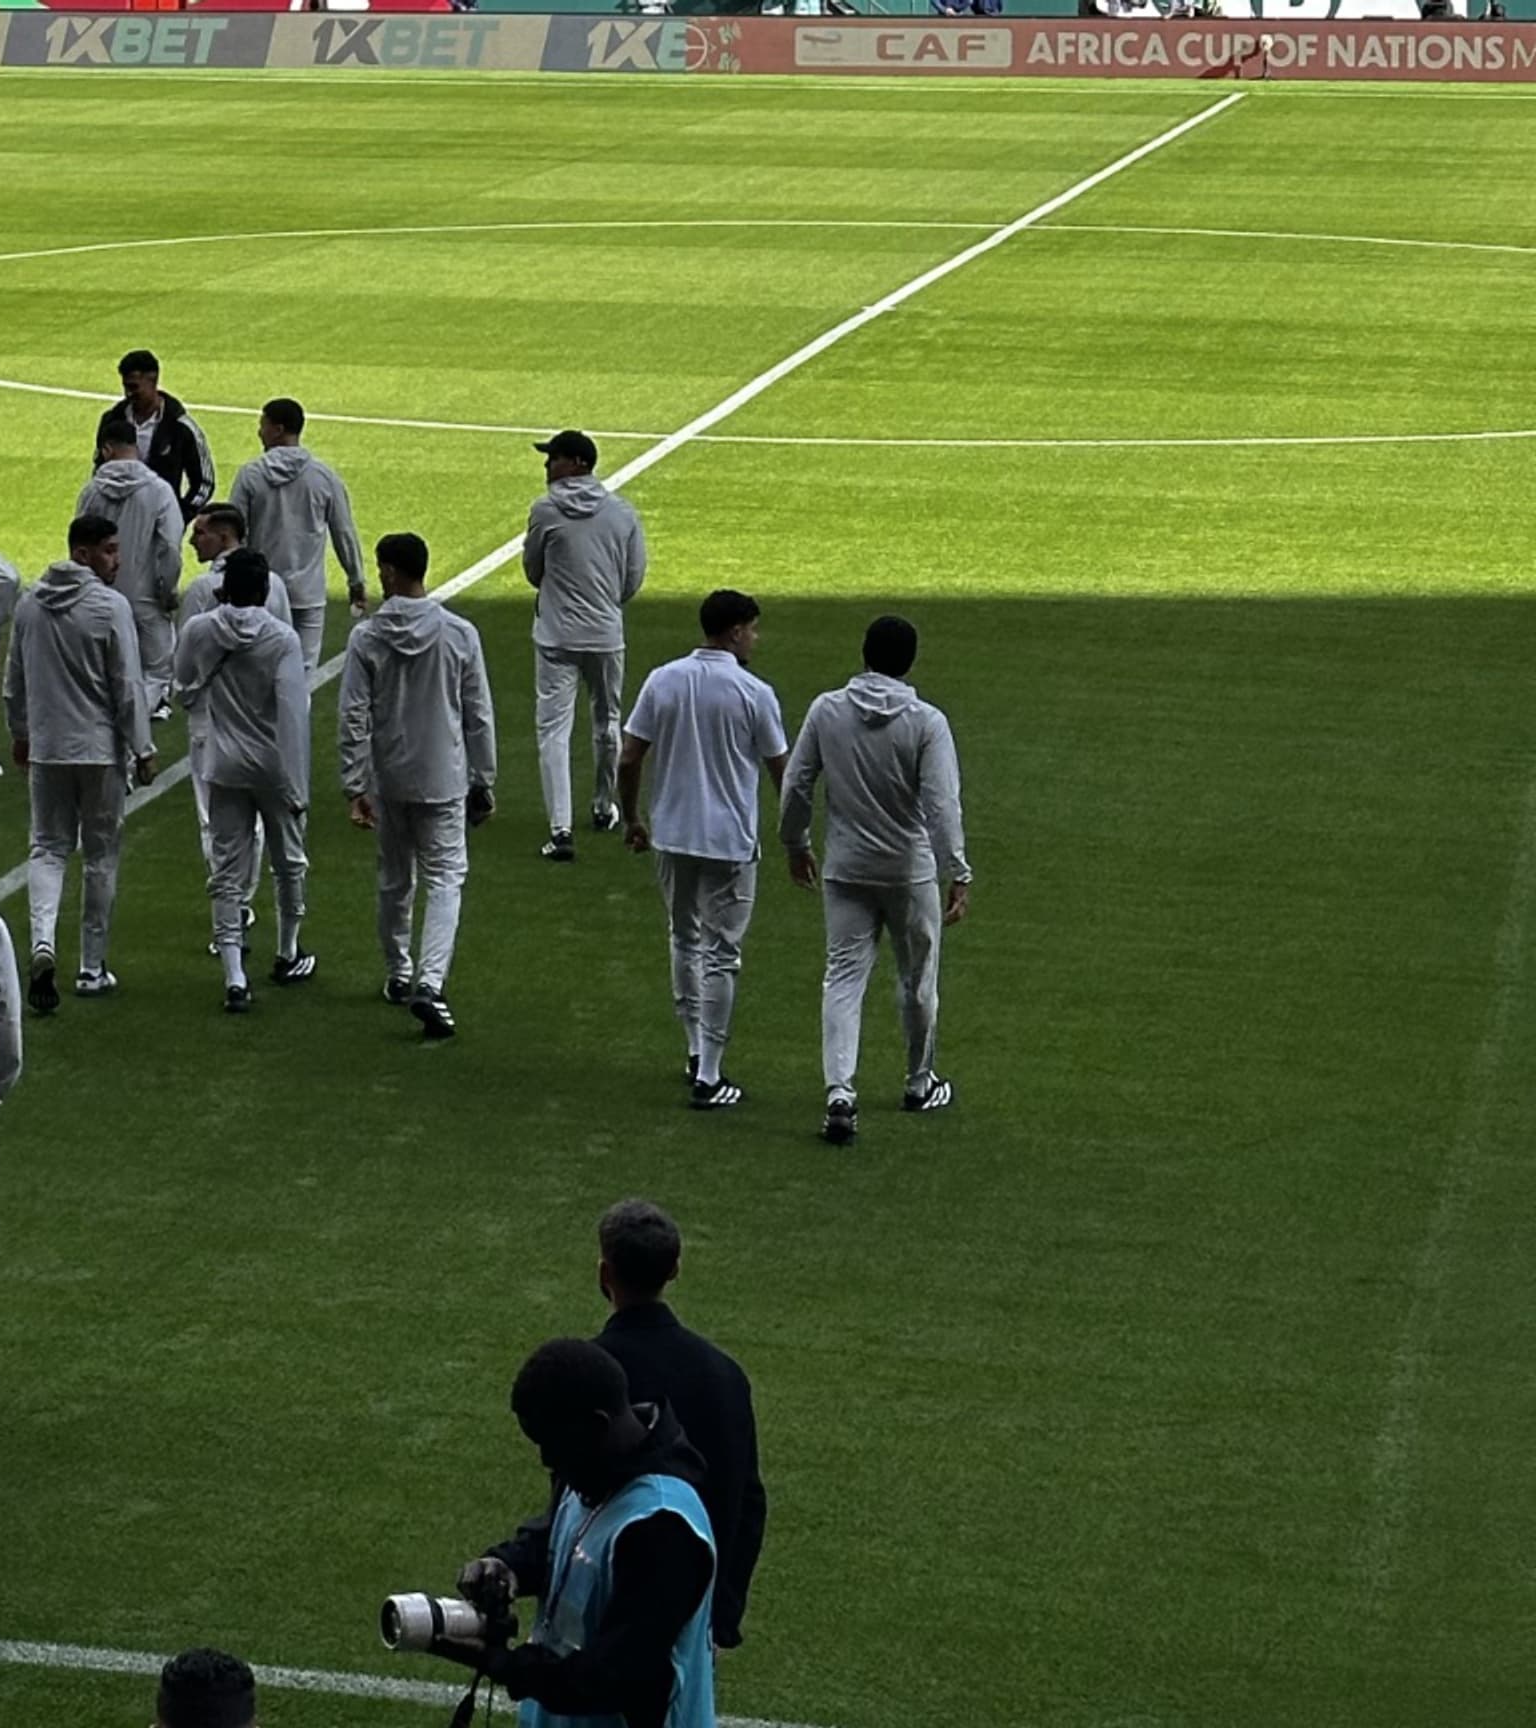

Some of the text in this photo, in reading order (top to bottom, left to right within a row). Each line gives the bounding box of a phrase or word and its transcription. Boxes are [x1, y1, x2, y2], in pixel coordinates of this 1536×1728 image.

[45, 17, 229, 64] 1XBET
[312, 19, 500, 67] 1XBET
[876, 34, 985, 61] CAF
[1026, 32, 1169, 66] AFRICA
[1177, 32, 1257, 66] CUP
[1265, 34, 1319, 67] OF
[1327, 35, 1505, 69] NATIONS
